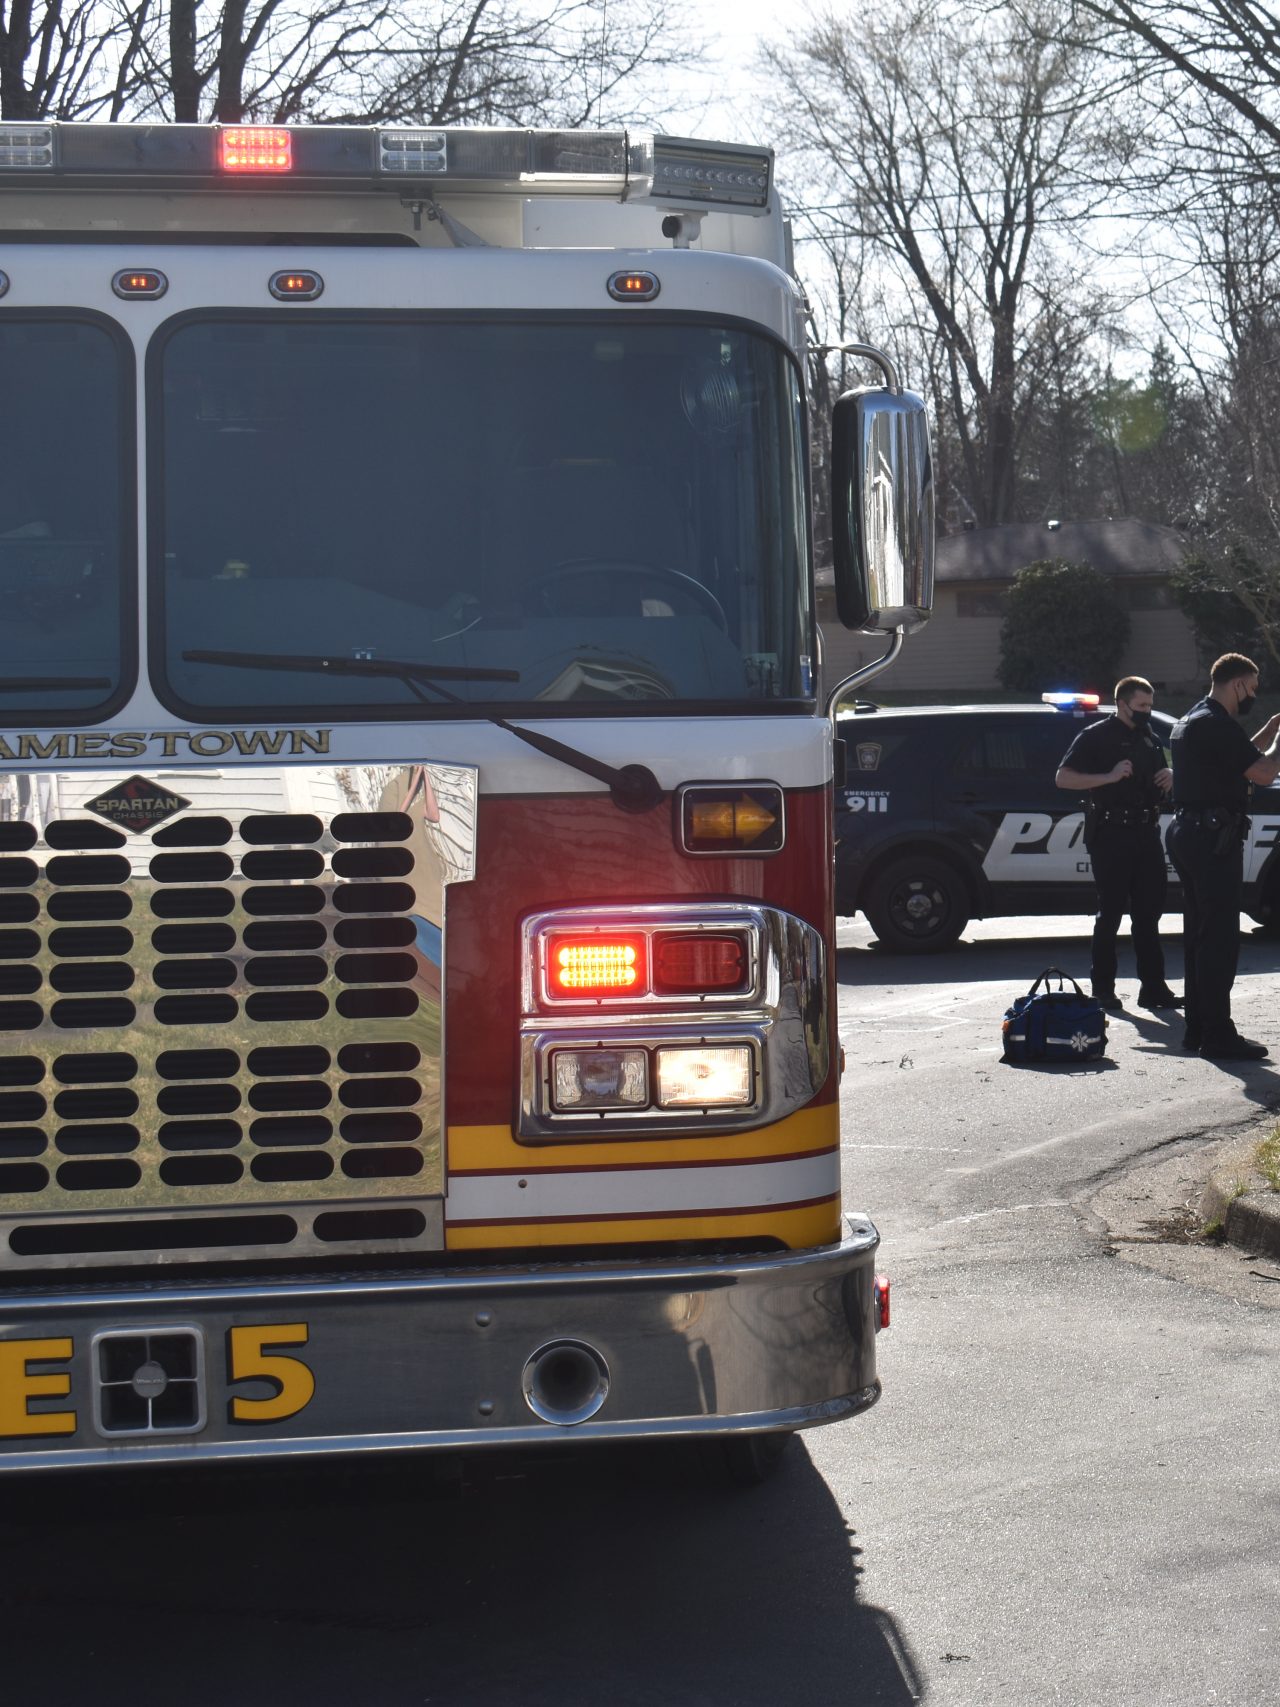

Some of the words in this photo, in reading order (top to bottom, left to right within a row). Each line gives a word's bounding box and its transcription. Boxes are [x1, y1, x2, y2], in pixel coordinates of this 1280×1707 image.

[843, 790, 890, 798] EMERGENCY
[96, 797, 179, 812] SPARTAN
[846, 796, 888, 812] 911
[112, 811, 164, 820] CHASSIS
[225, 1321, 316, 1425] 5
